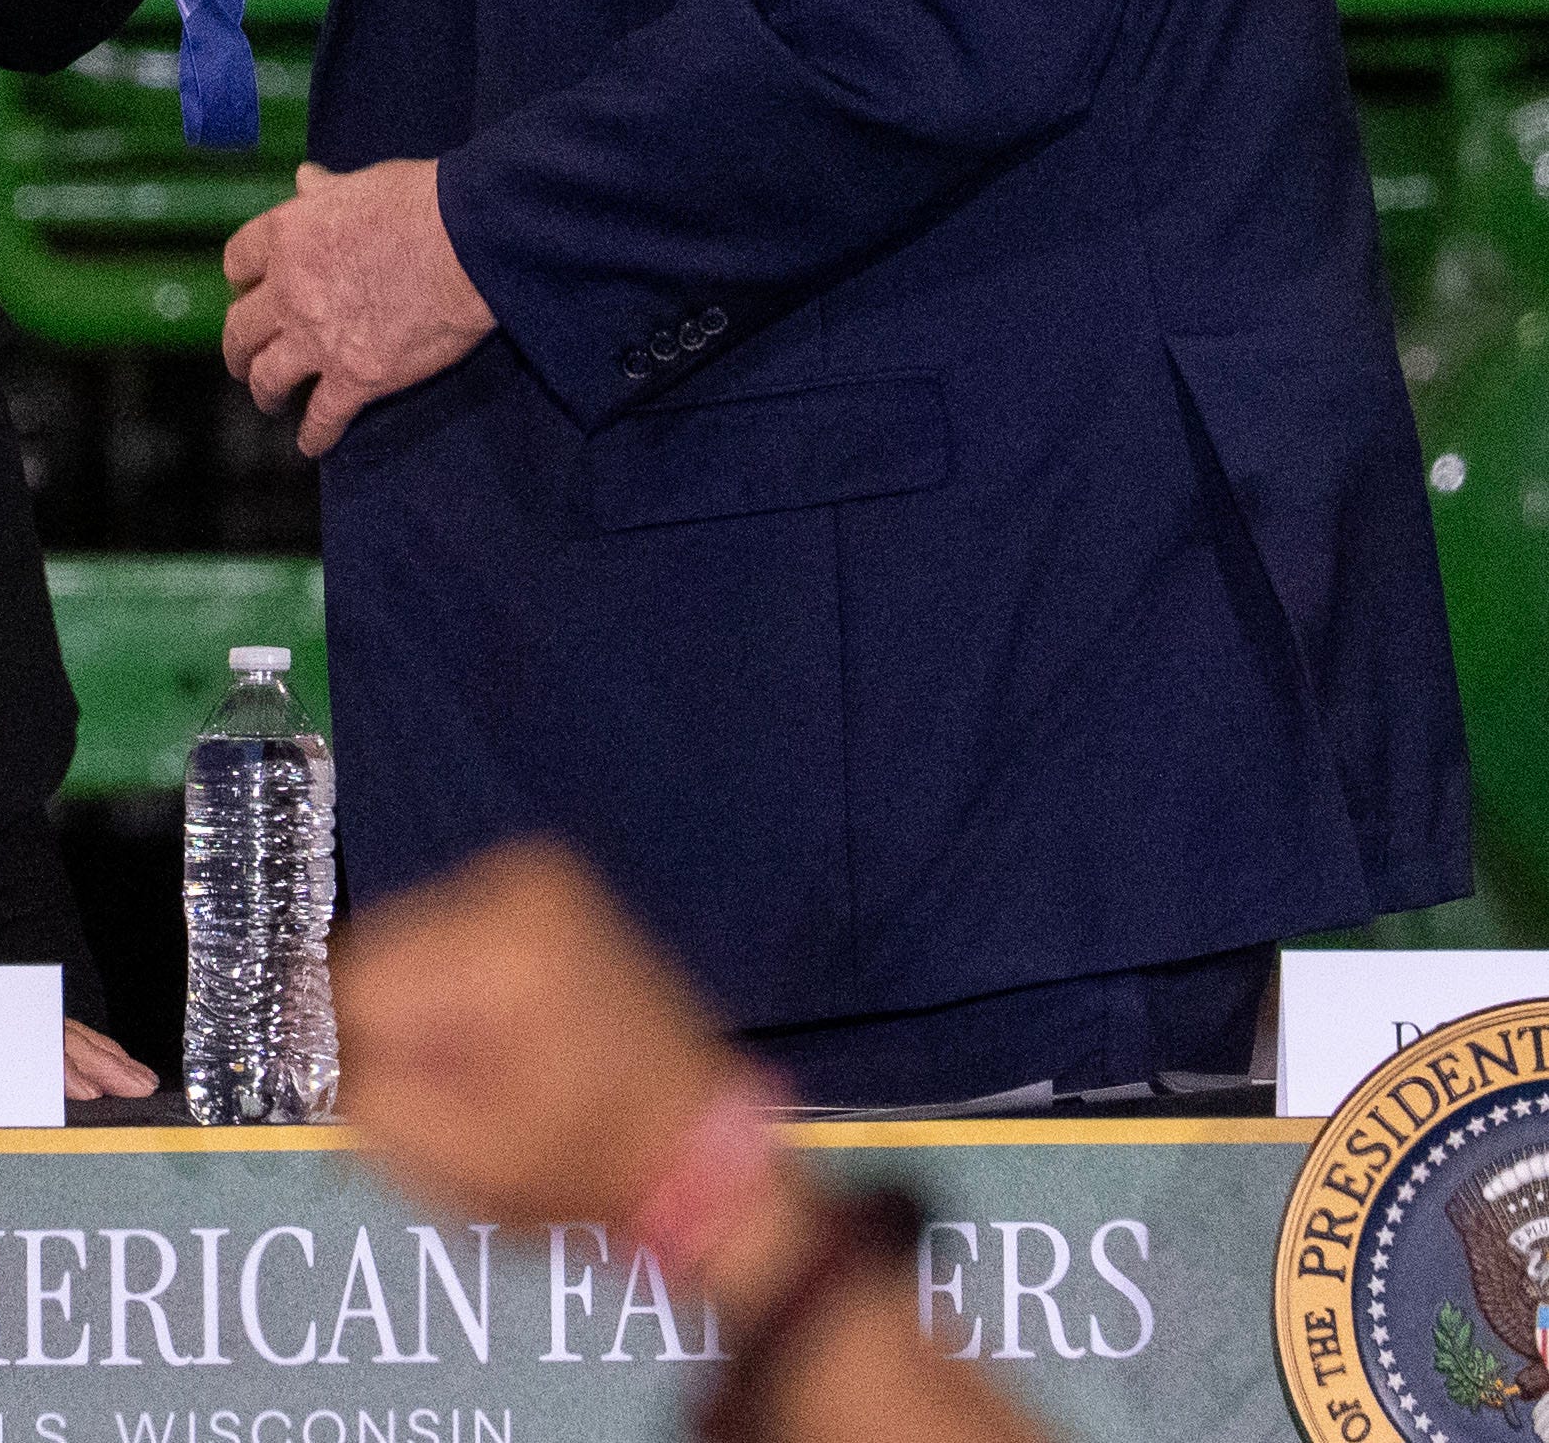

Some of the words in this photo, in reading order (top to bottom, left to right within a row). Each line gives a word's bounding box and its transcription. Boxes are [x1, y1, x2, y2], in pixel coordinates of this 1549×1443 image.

[1298, 1024, 1549, 1283] PRESIDENT
[538, 1219, 1156, 1363] FAERS
[1304, 1307, 1347, 1387] THE
[1326, 1399, 1372, 1443] OF
